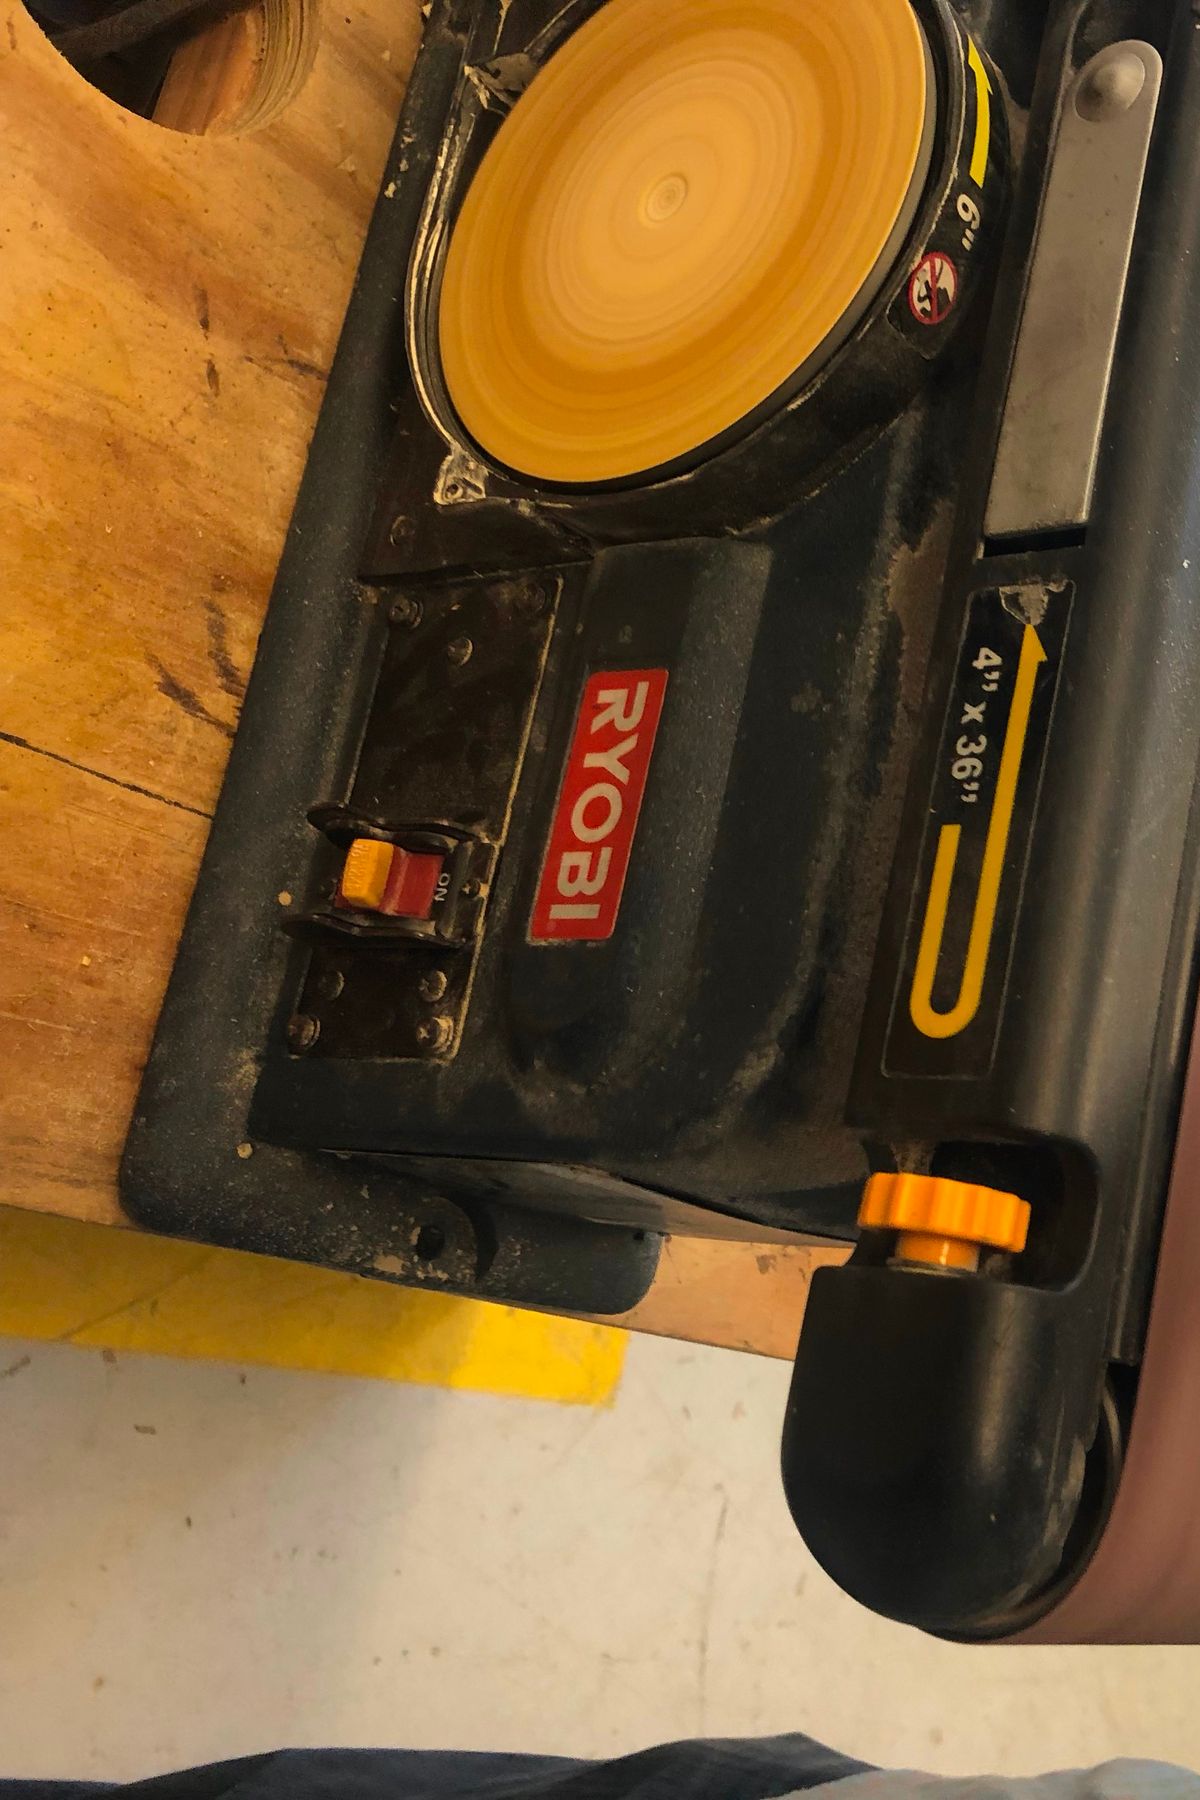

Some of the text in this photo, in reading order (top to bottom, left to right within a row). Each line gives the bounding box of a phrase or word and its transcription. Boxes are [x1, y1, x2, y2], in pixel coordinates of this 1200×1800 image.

[956, 193, 981, 251] 6"
[961, 701, 986, 724] x
[549, 681, 650, 919] RYOBI
[434, 872, 450, 902] ON
